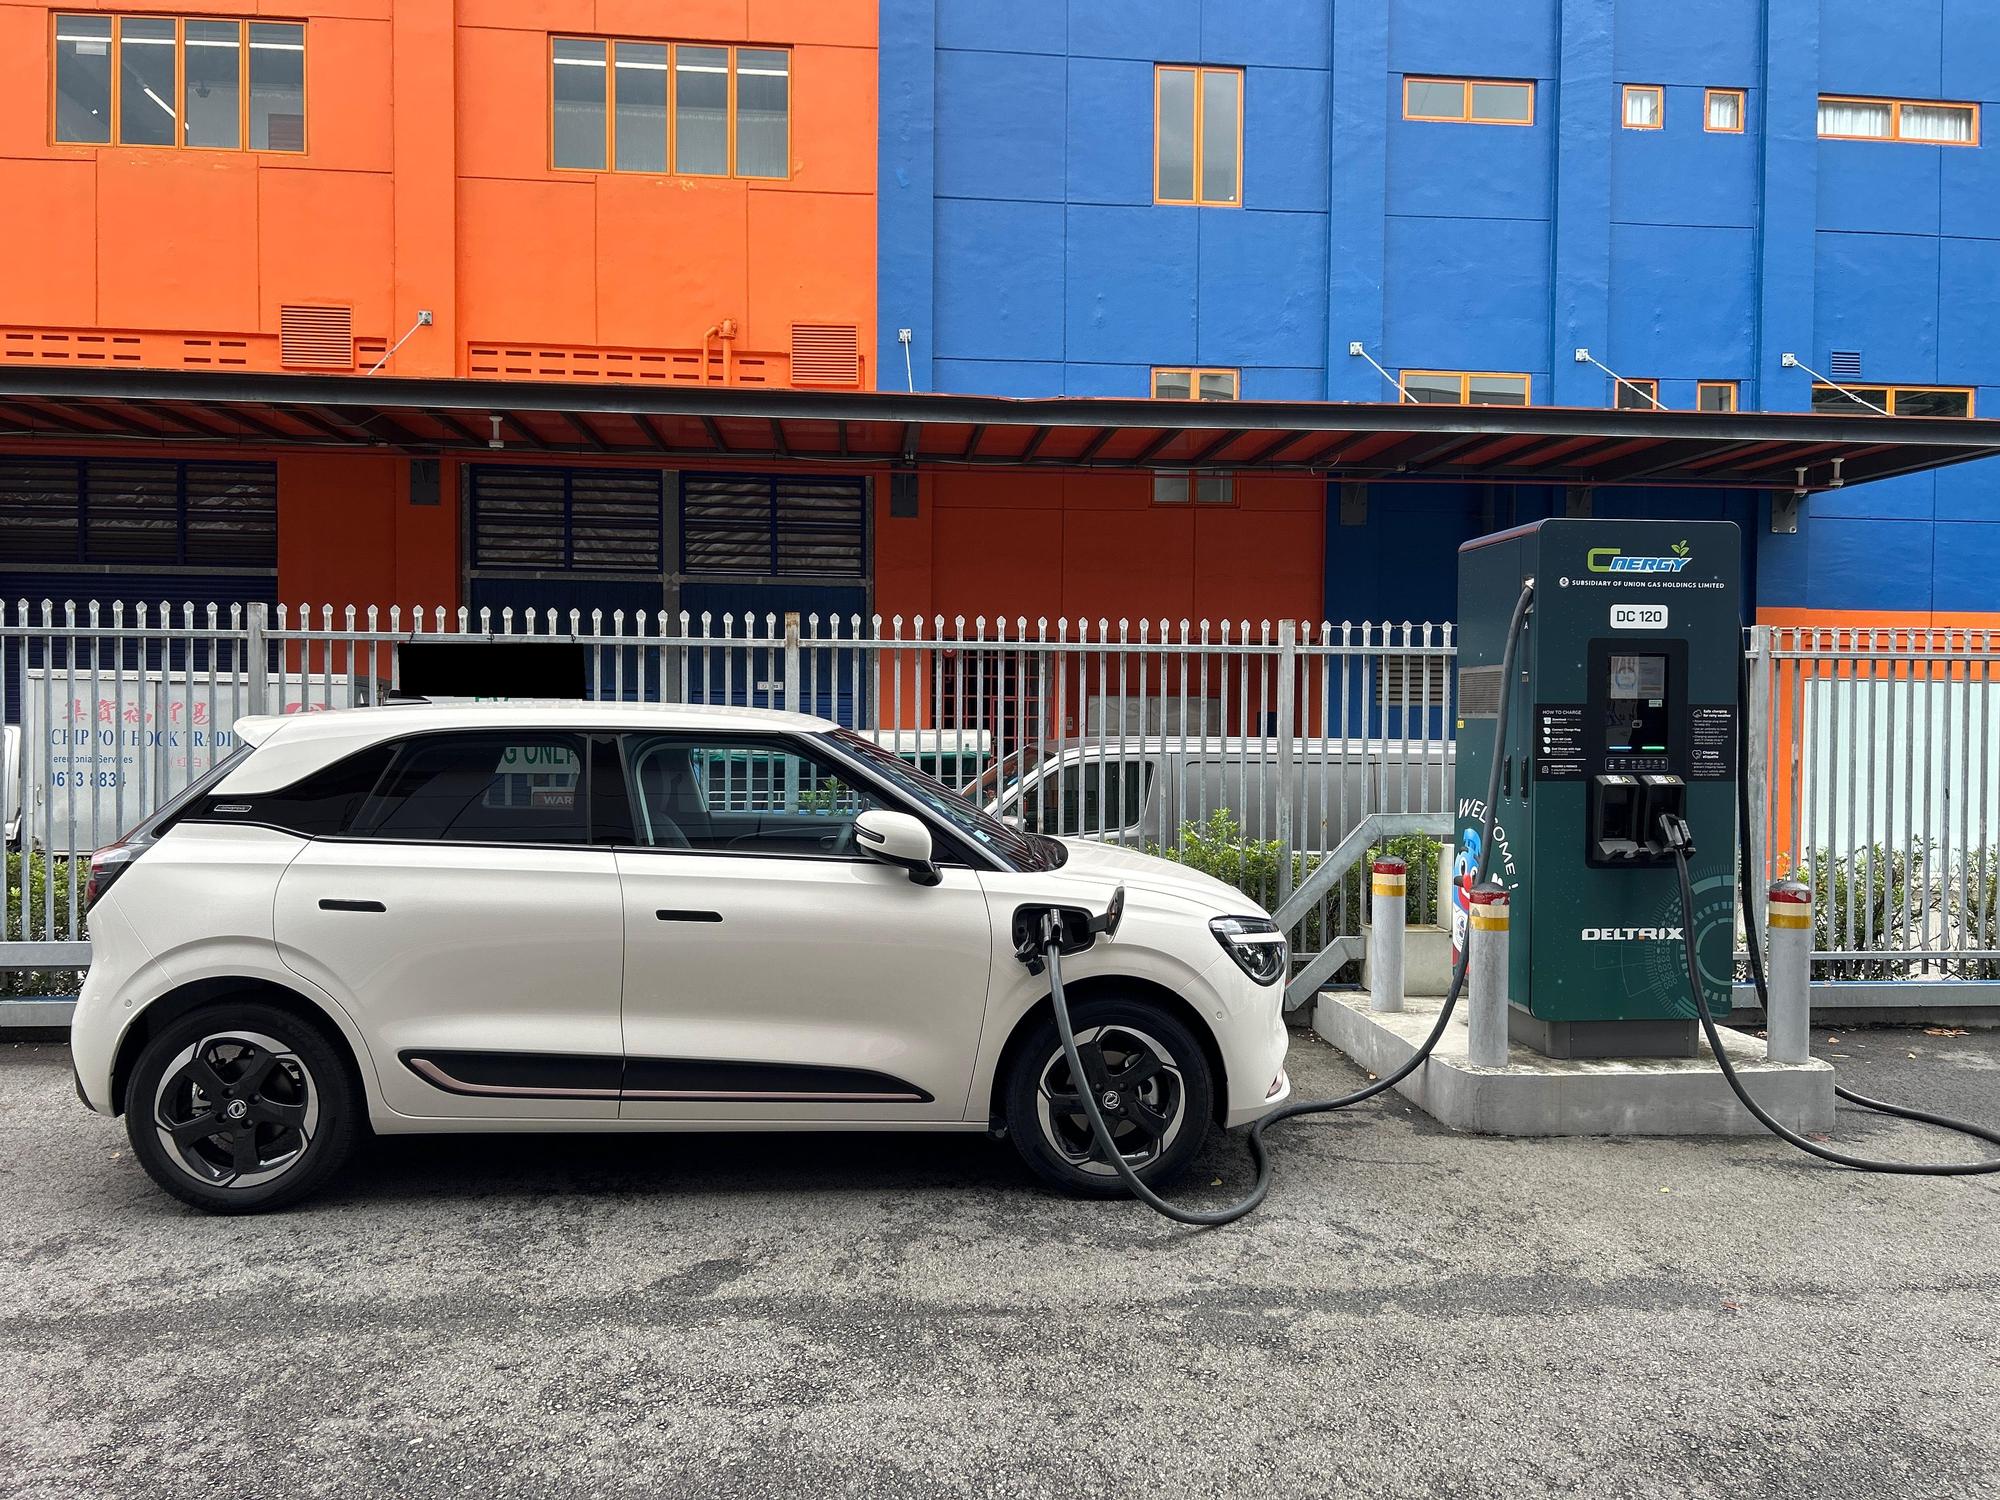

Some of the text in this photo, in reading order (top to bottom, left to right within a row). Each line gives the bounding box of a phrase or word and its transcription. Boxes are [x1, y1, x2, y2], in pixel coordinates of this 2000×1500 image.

[1571, 579, 1611, 587] SUBSIDIARY
[1612, 580, 1623, 588] OF
[1623, 580, 1646, 588] UNION
[1662, 581, 1697, 589] HOLDINGS
[1616, 610, 1662, 623] DC 120
[1458, 798, 1516, 876] WELOME
[1581, 927, 1684, 941] DELTRIX
